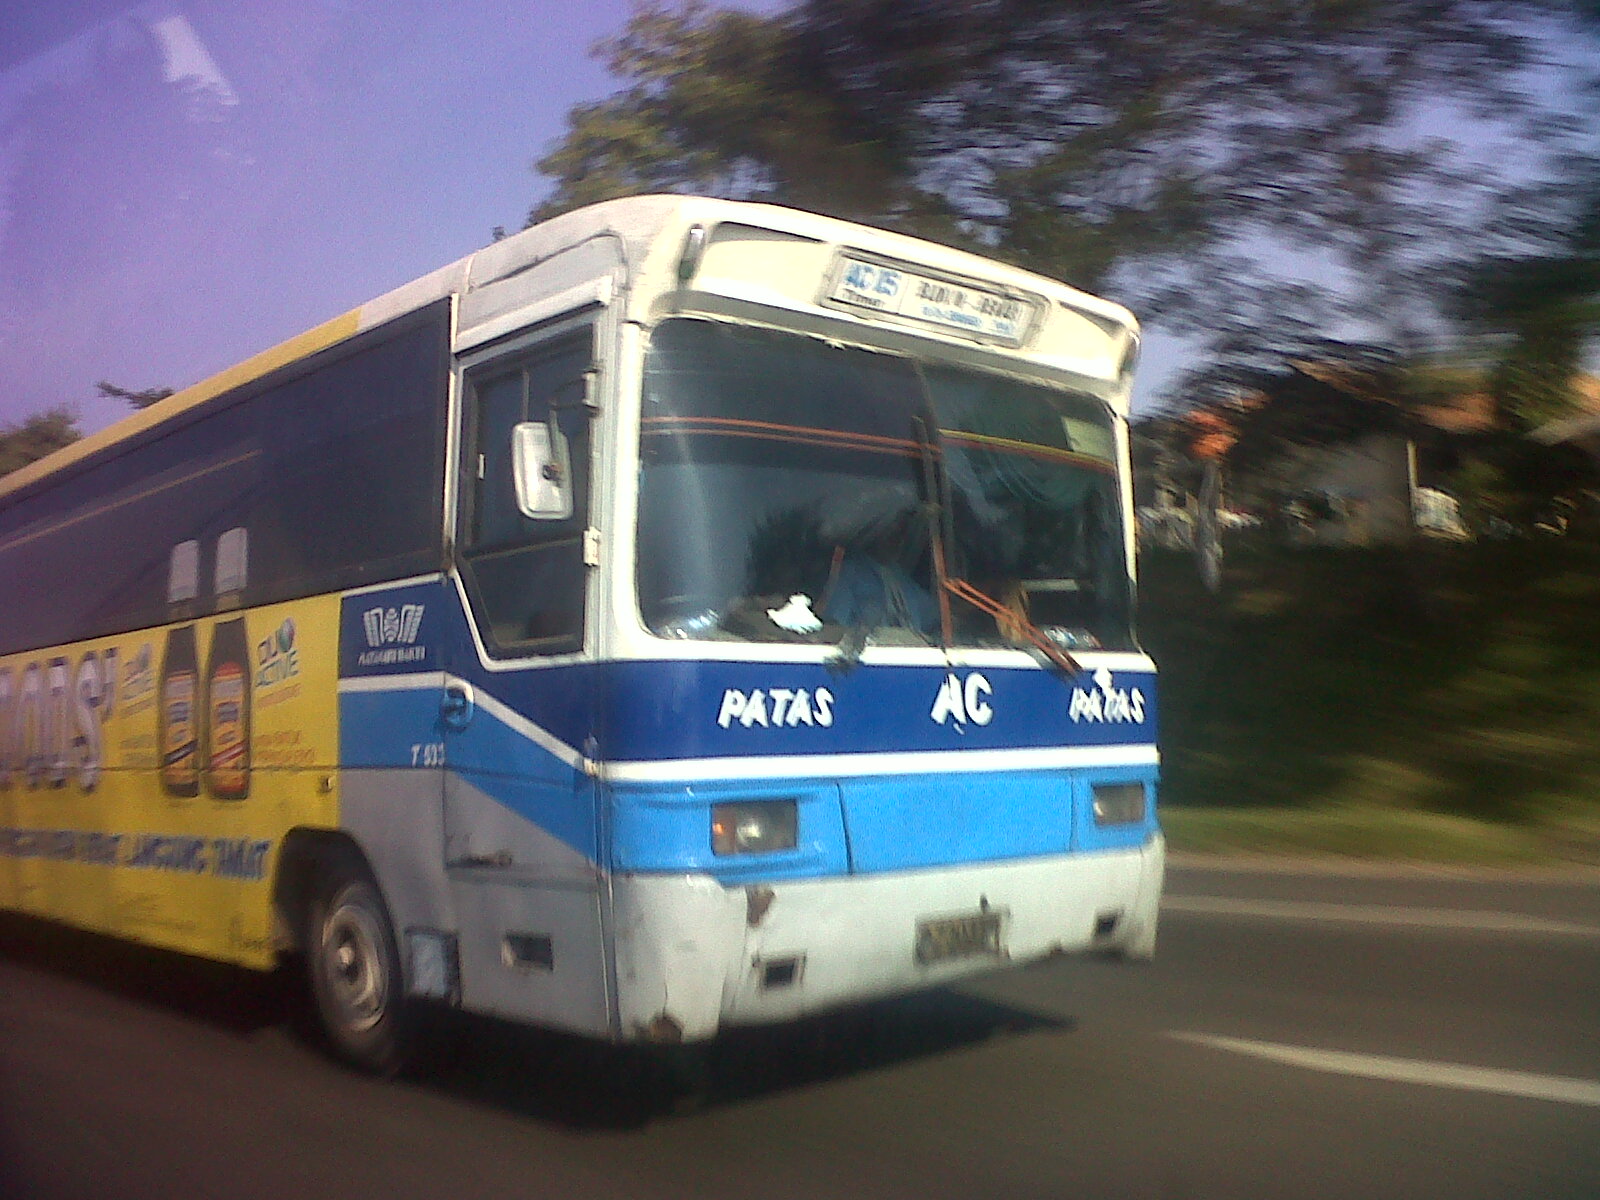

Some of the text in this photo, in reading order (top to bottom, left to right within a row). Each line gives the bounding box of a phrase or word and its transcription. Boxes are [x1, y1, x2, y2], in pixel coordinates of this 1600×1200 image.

[717, 686, 834, 729] PATAS
[930, 672, 993, 730] AC
[1069, 684, 1146, 725] PATAS
